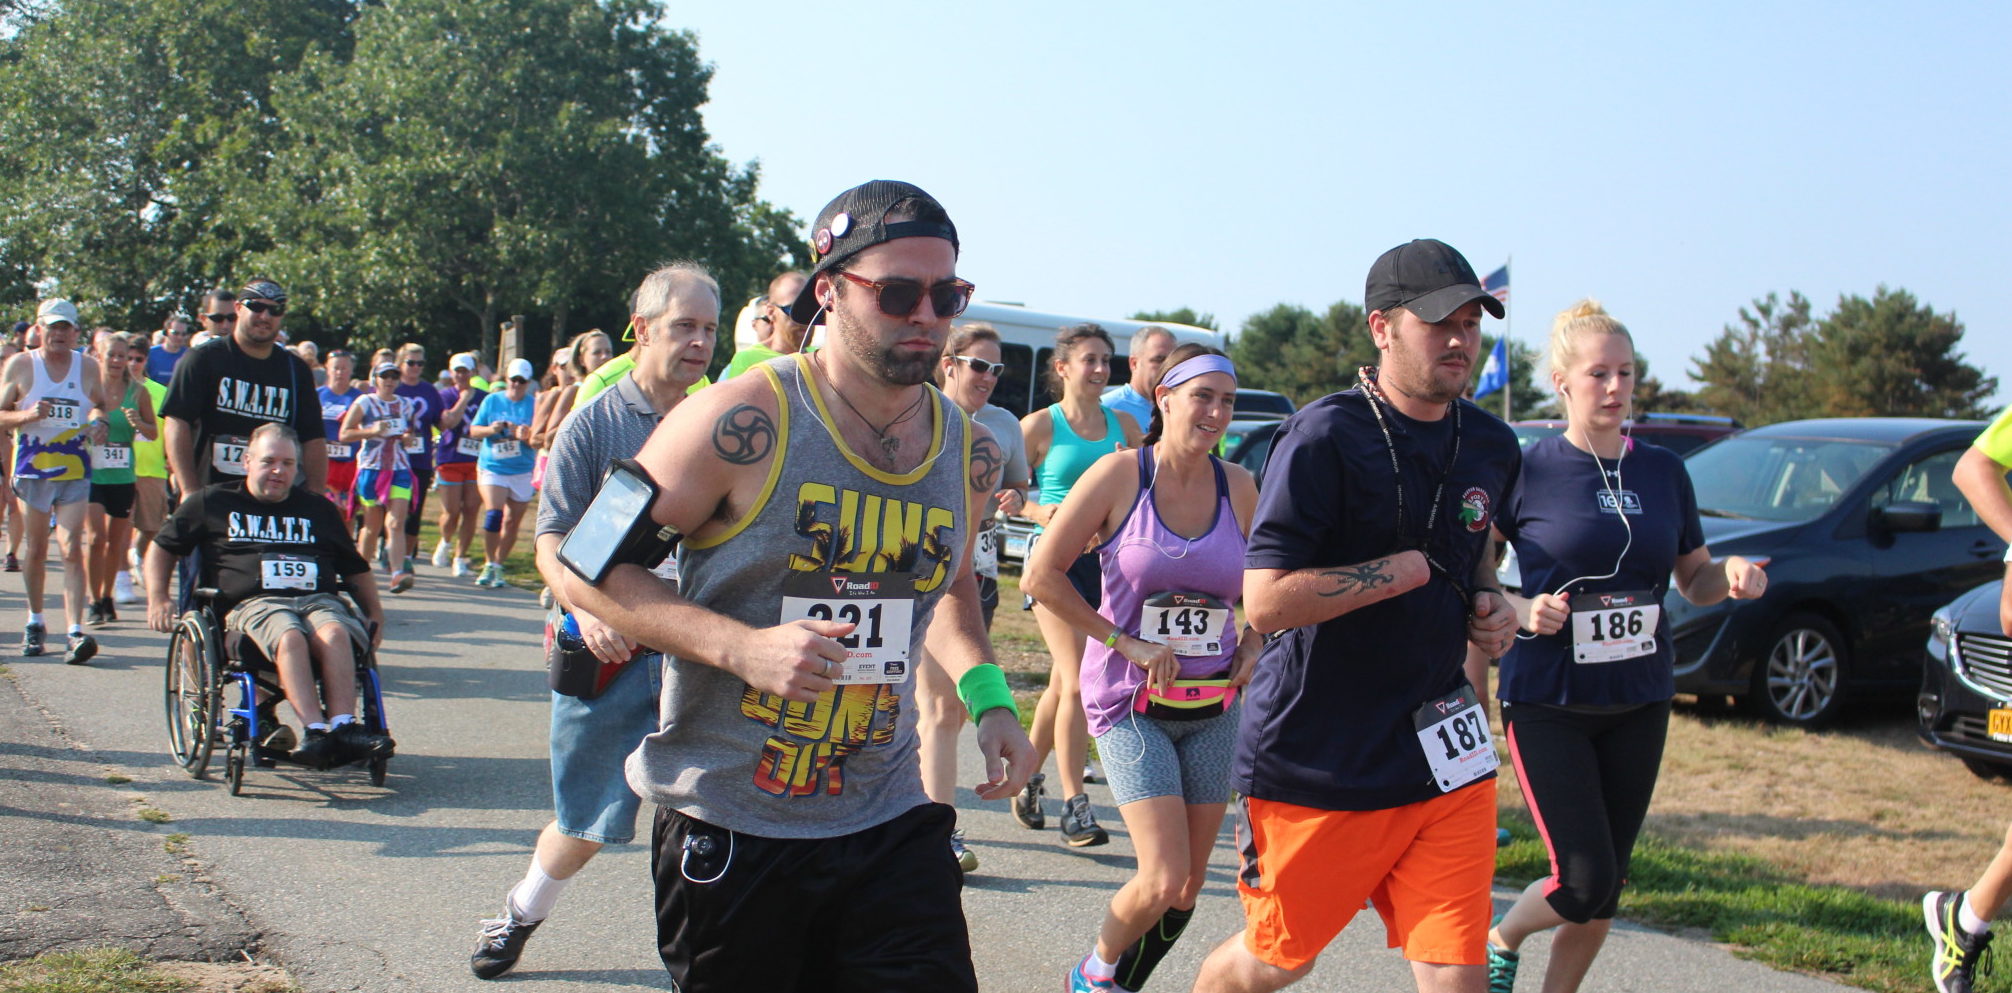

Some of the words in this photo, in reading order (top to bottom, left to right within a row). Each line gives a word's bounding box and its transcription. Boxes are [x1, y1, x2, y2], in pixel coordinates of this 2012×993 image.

[49, 406, 73, 419] 318
[104, 448, 124, 460] 341
[223, 445, 244, 463] 17
[228, 511, 316, 544] S.W.A.T.T.
[788, 482, 955, 593] SUNS
[272, 562, 306, 577] 159
[846, 581, 880, 590] RoadID
[1157, 608, 1210, 635] 143
[1591, 609, 1643, 642] 186
[1436, 710, 1488, 761] 187
[753, 736, 862, 798] OUT
